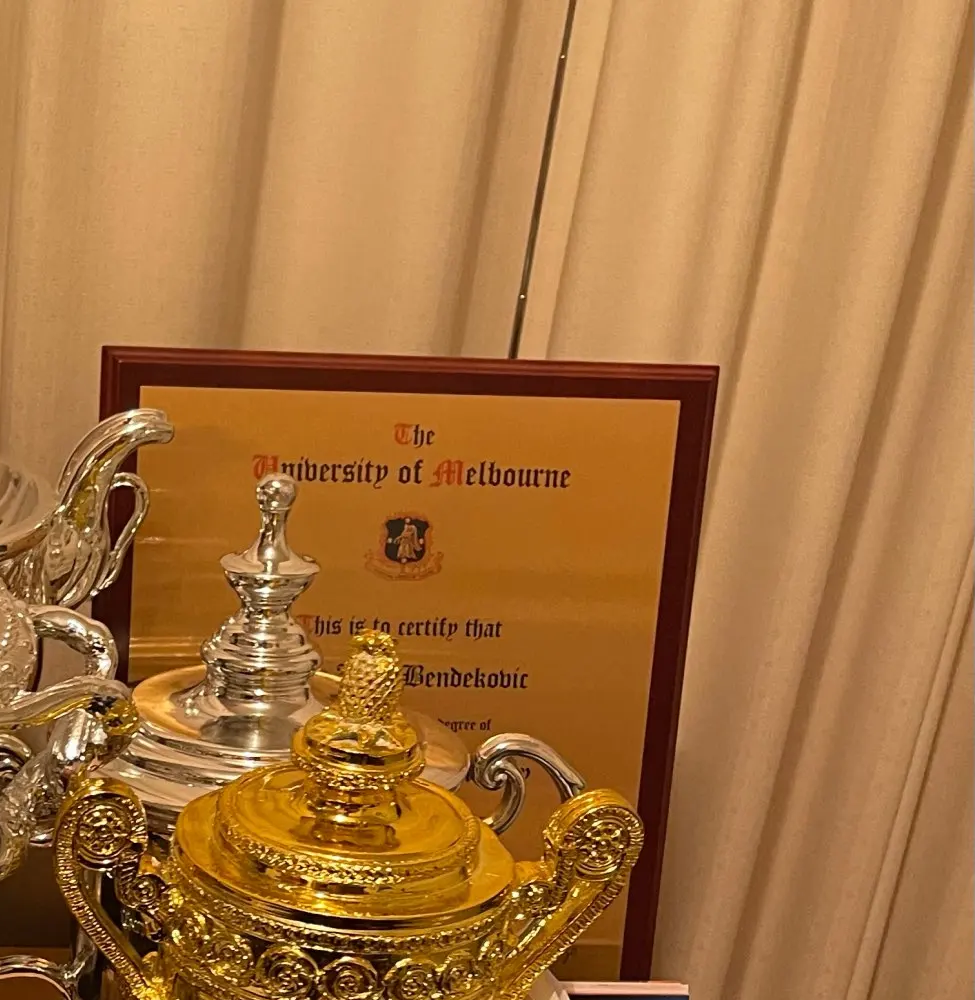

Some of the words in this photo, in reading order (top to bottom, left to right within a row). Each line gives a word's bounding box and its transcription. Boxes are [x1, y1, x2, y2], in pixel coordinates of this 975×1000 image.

[394, 423, 435, 448] The
[252, 454, 388, 489] University
[398, 459, 423, 484] of
[429, 459, 571, 488] Melbourne
[349, 616, 365, 635] is
[374, 618, 391, 635] to
[398, 617, 458, 641] certify
[465, 618, 503, 640] that
[402, 664, 528, 689] Bendekovic
[479, 718, 492, 731] of
